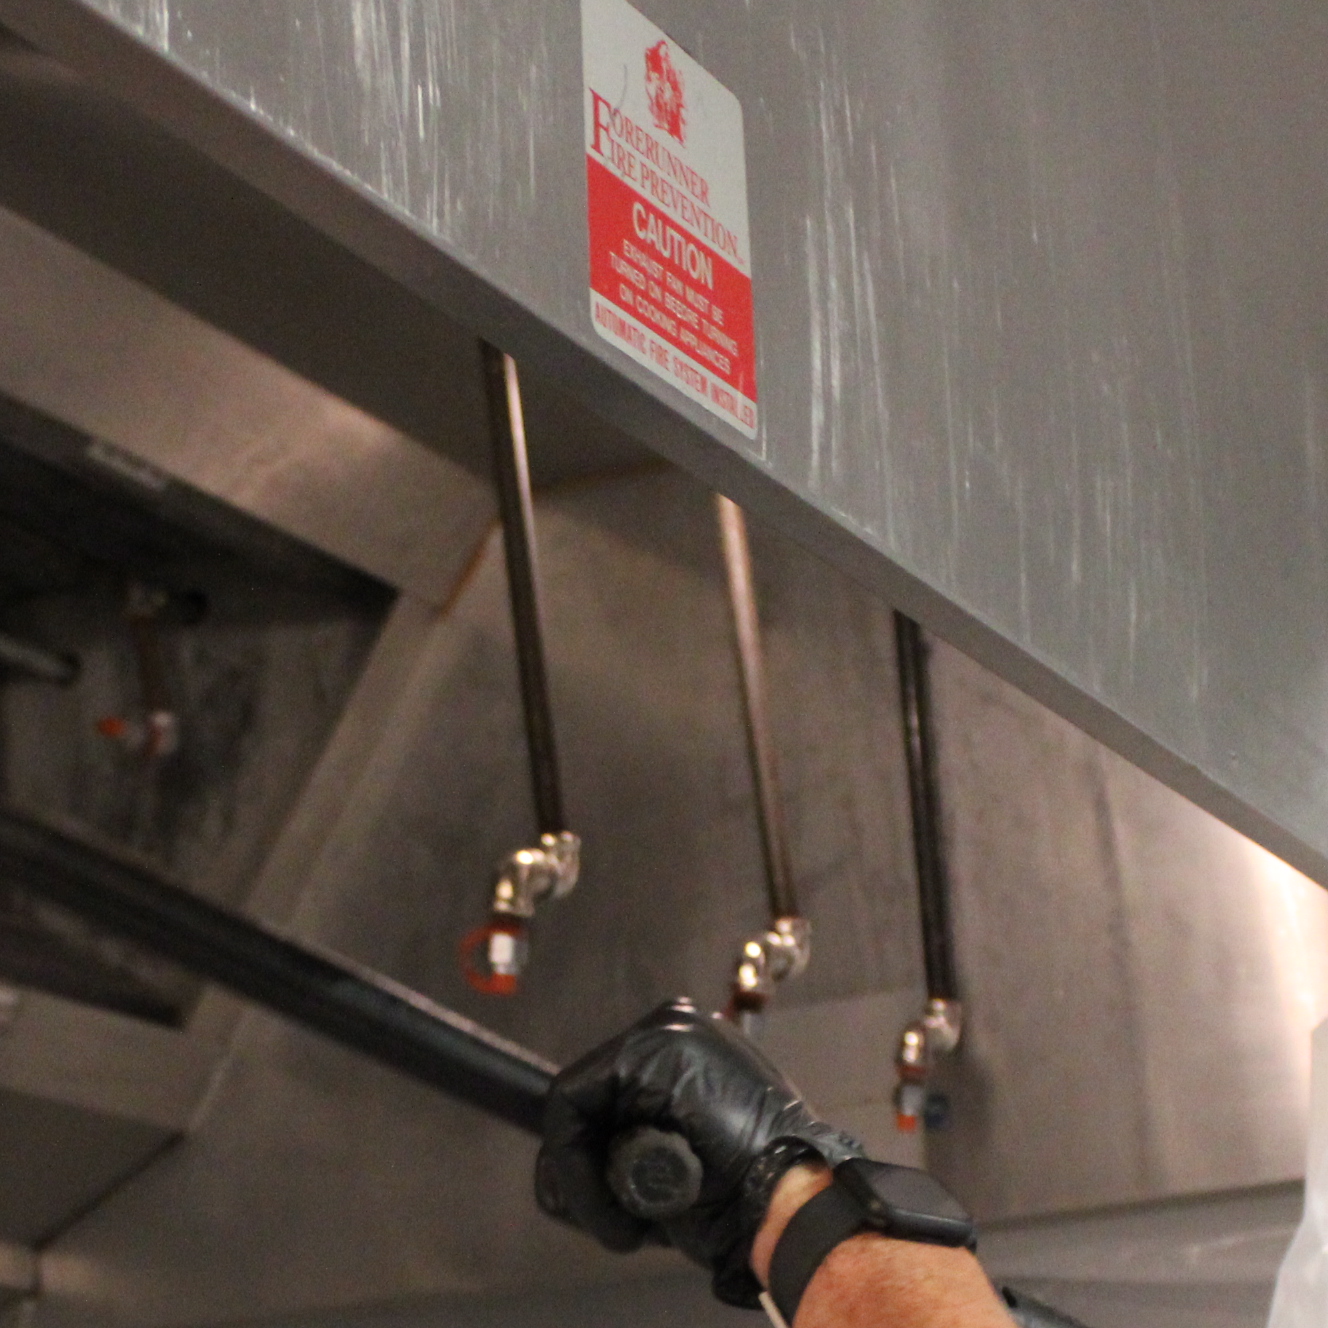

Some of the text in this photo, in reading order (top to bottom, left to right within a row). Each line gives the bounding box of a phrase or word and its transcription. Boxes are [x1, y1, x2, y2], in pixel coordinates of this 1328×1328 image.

[632, 201, 713, 289] CAUTION
[638, 160, 739, 260] PREVENTION
[608, 251, 646, 291] TURNED
[647, 278, 663, 303] ON
[700, 317, 739, 357] TURNING
[618, 282, 731, 375] ON COOKING APPLIANCES
[665, 269, 684, 297] FAN
[685, 285, 710, 315] MUST
[711, 303, 724, 327] BE
